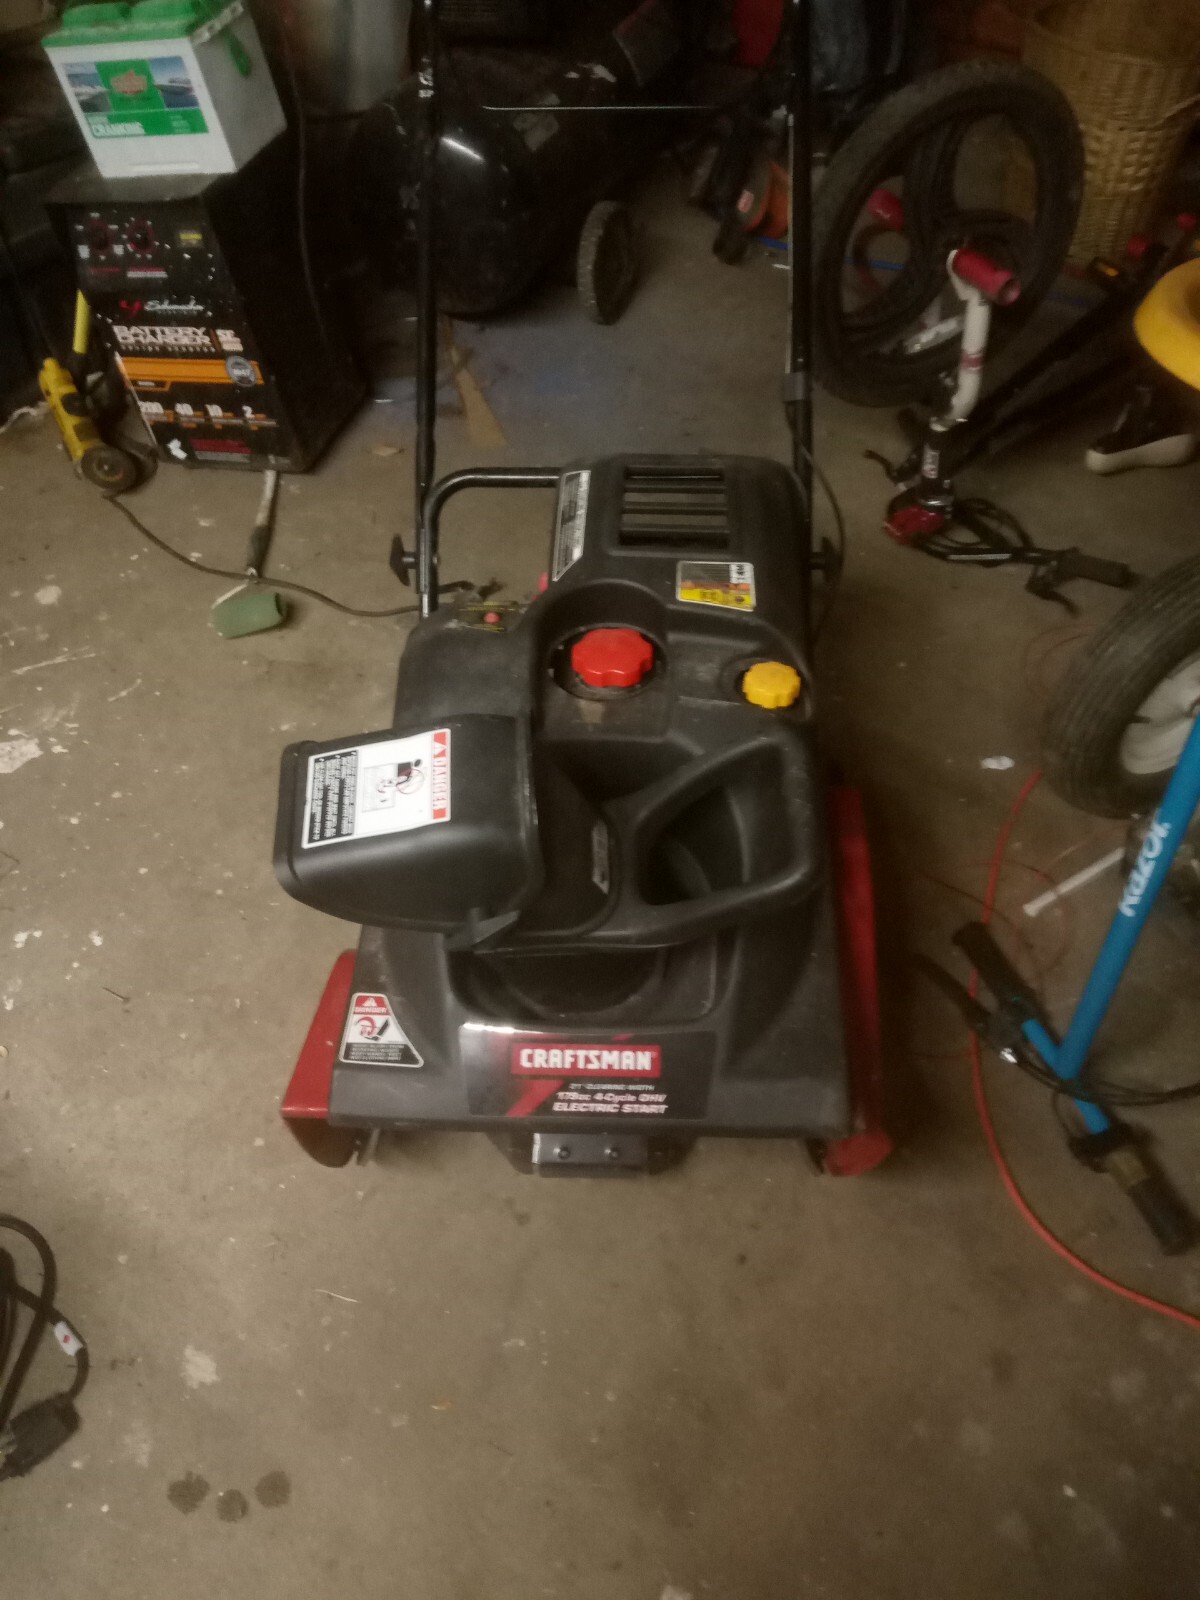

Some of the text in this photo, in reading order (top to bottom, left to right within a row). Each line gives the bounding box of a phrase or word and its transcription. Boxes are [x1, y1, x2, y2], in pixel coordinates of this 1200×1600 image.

[174, 402, 194, 416] 40
[205, 403, 223, 417] 10
[241, 404, 255, 419] 2
[432, 757, 448, 810] DANGER
[1117, 821, 1172, 918] razor
[519, 1048, 652, 1071] CRAFTSMAN
[552, 1102, 670, 1114] ELECTRIC START
